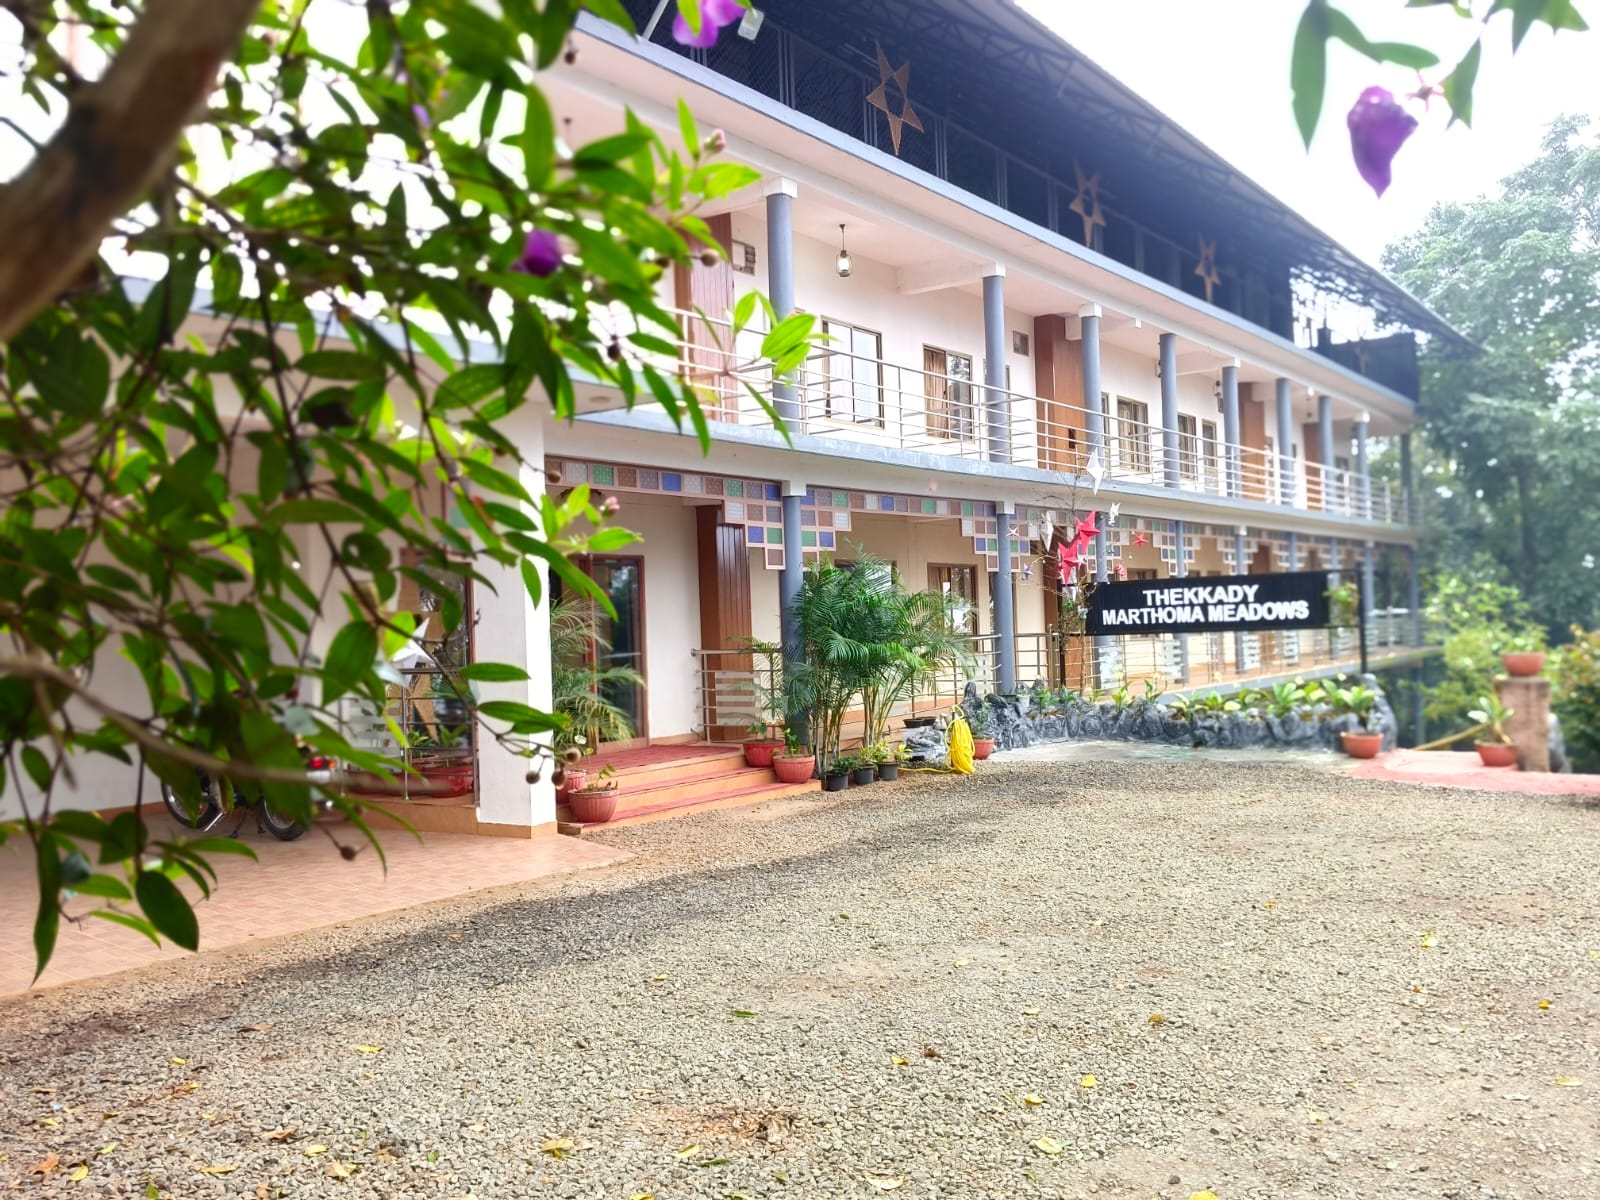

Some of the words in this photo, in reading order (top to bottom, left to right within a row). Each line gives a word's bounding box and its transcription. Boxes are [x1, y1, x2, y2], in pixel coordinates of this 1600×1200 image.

[1143, 585, 1259, 606] THEKKADY
[1102, 604, 1204, 625] MARTHOMA
[1208, 600, 1310, 622] MEADOWS
